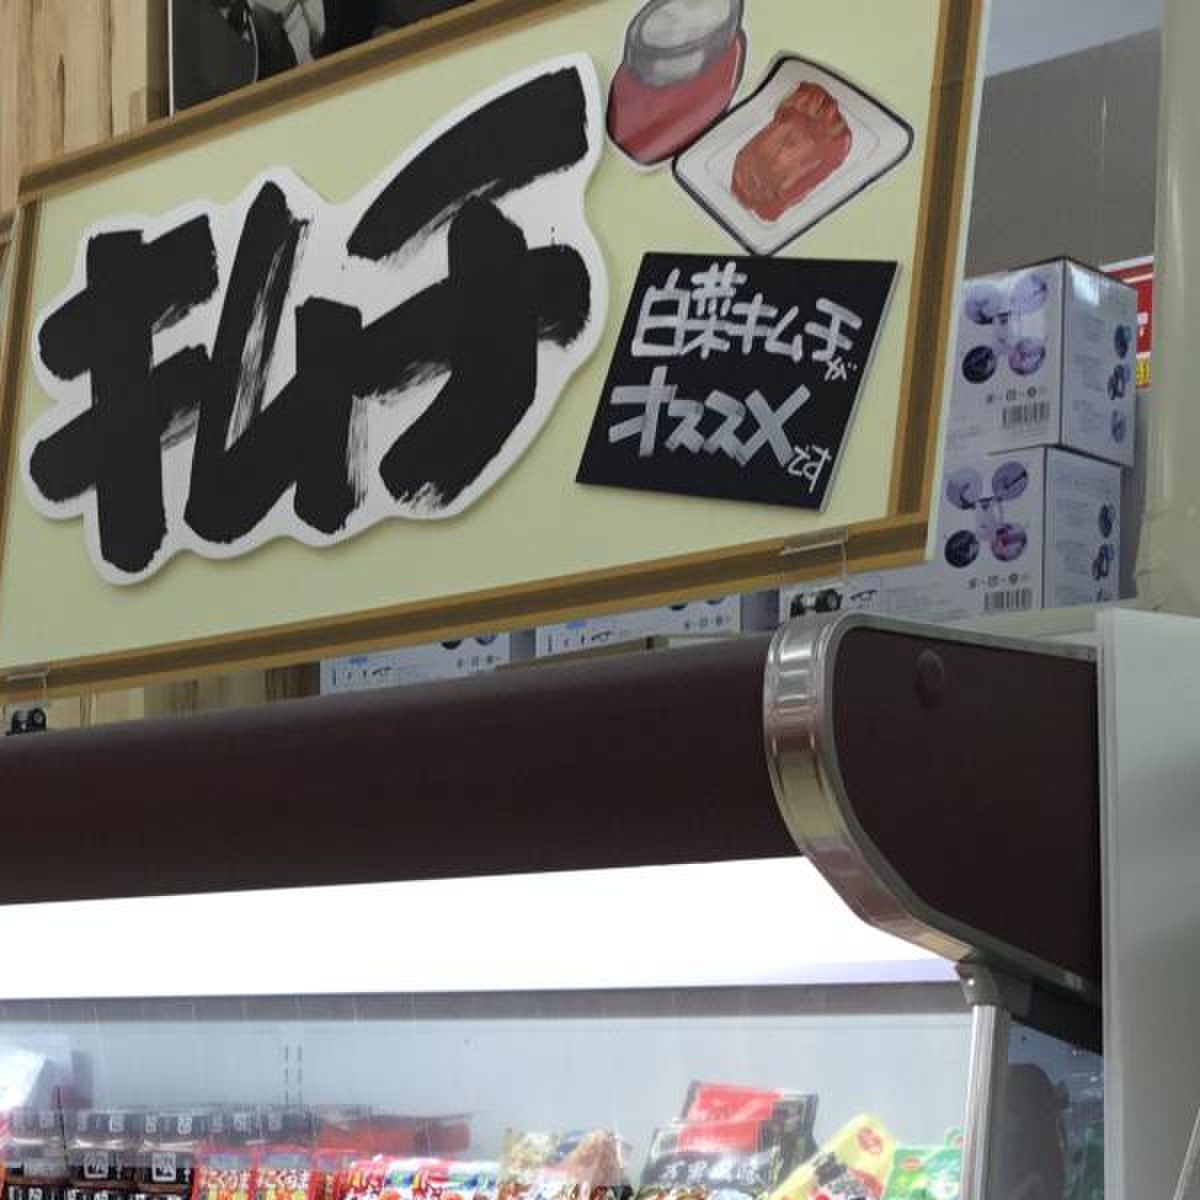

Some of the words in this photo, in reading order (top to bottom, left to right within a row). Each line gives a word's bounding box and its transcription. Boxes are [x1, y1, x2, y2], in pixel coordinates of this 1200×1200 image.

[29, 65, 591, 573] キムチ
[631, 262, 863, 382] 白菜キムチが
[606, 366, 832, 493] オススメです
